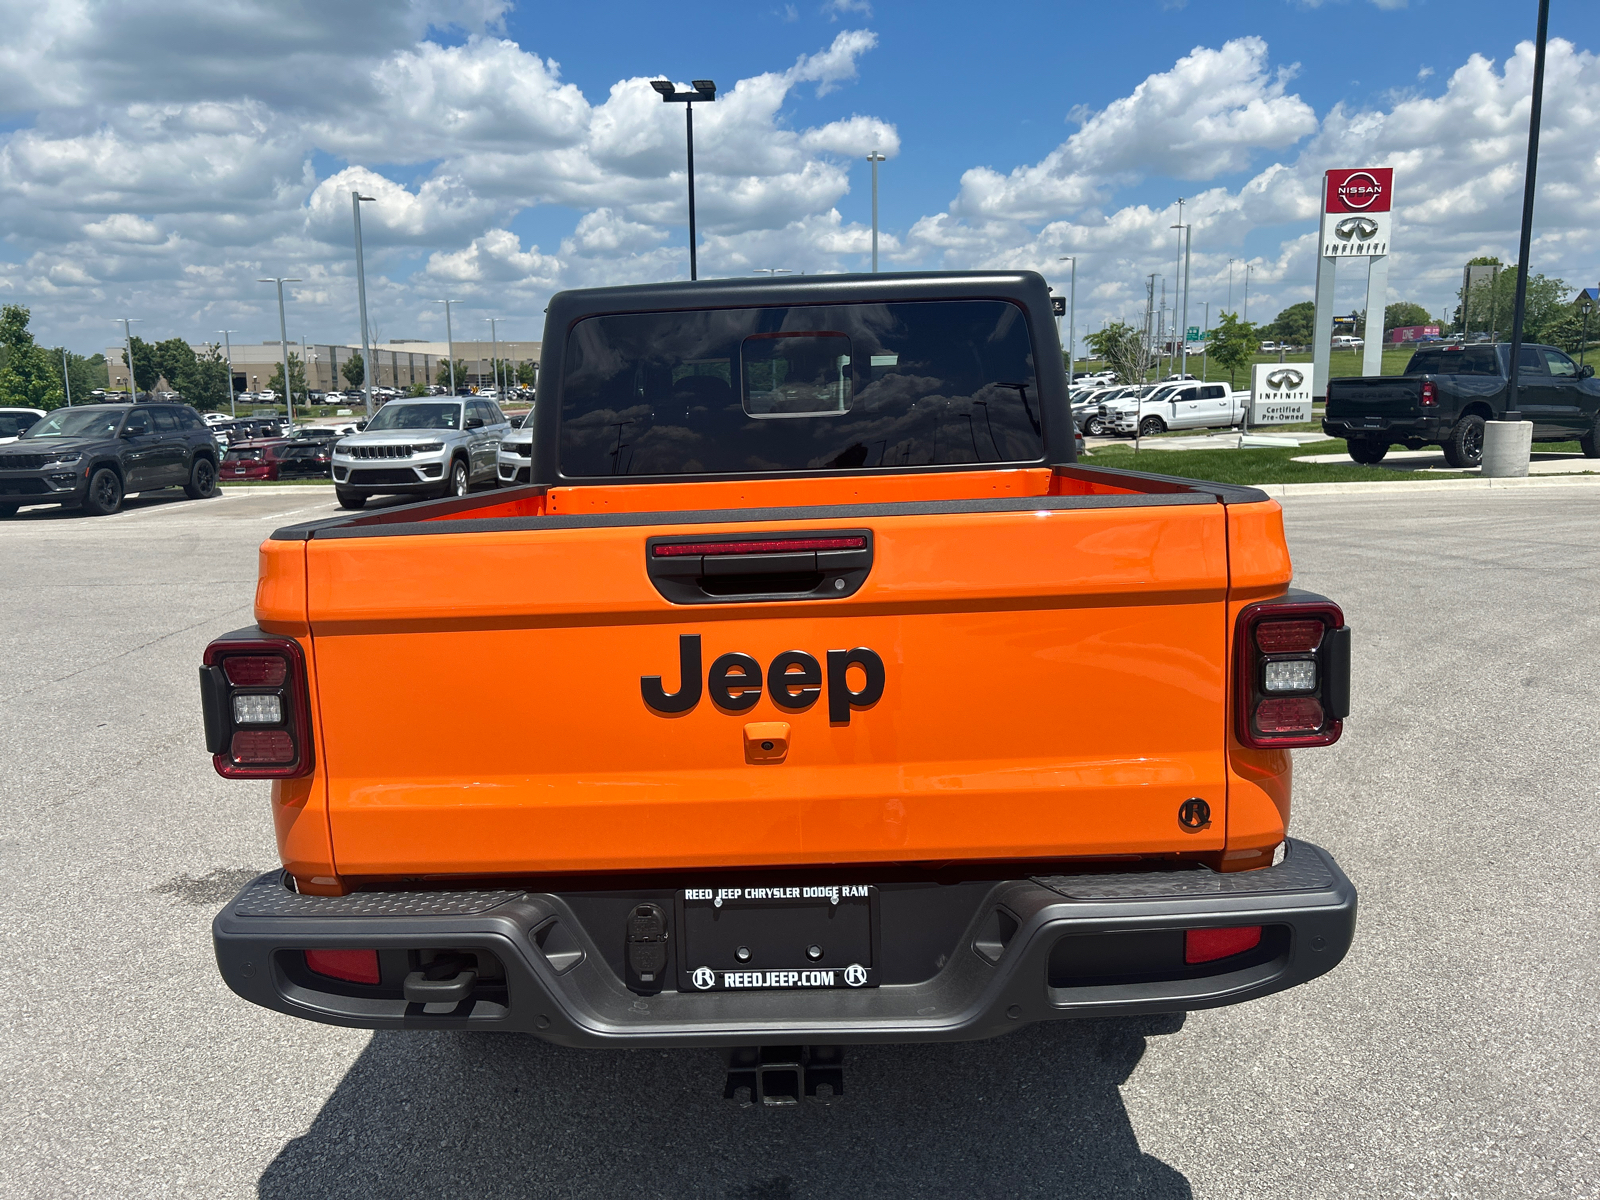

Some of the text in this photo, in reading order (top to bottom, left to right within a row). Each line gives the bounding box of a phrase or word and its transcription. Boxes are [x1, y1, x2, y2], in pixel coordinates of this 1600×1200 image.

[1338, 186, 1382, 194] NISSAN
[1325, 243, 1386, 255] INFINITI
[1260, 392, 1309, 400] INFINITI
[1266, 406, 1301, 414] Certified
[1262, 413, 1304, 421] Pre-Owned
[641, 634, 885, 724] Jeep
[684, 885, 869, 900] REED JEEP CHRYSLER DODGE RAM
[724, 971, 835, 988] REEDJEEP.COM
